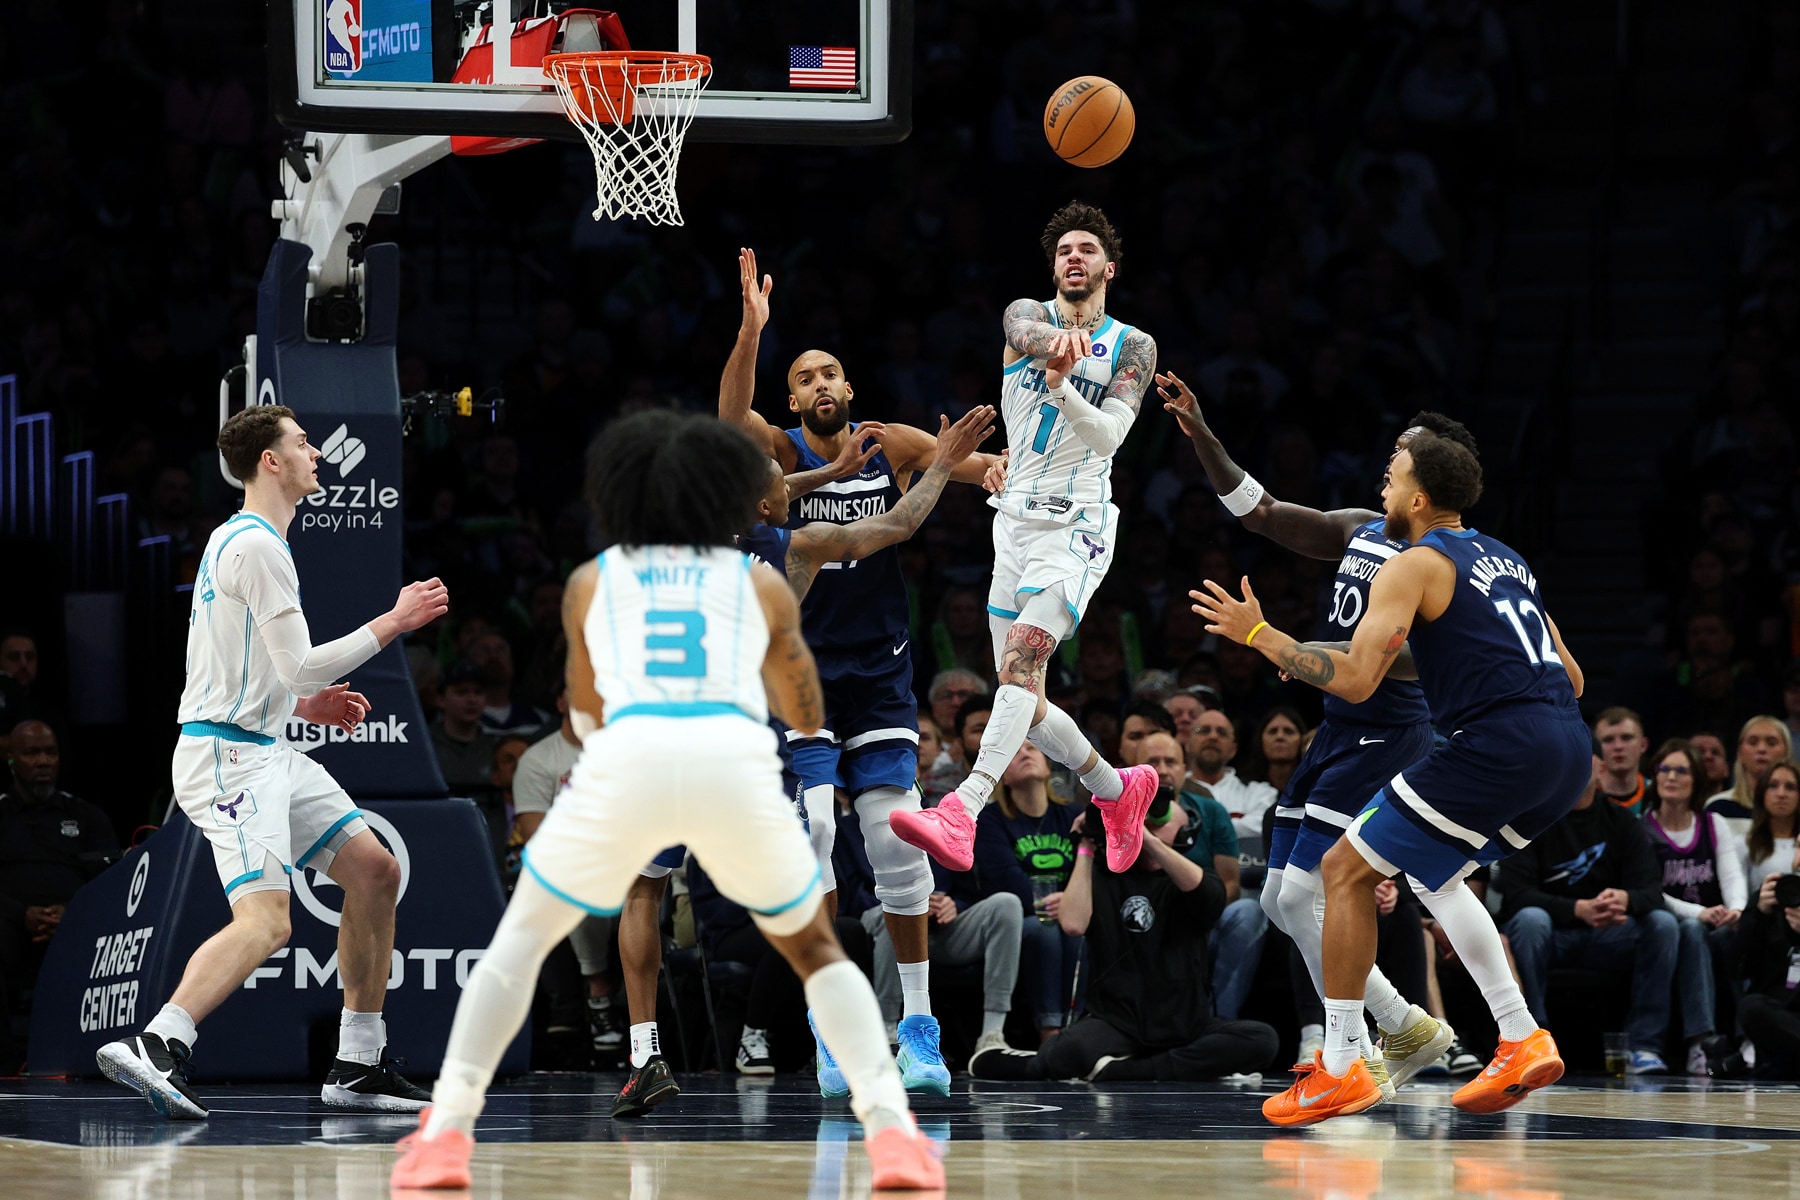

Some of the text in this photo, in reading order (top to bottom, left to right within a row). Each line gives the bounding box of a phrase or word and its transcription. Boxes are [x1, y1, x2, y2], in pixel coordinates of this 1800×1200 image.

[329, 52, 348, 67] NBA
[361, 22, 420, 59] CFMOTO
[1048, 81, 1095, 129] Wilson
[1031, 401, 1060, 455] 1
[296, 478, 400, 509] ezzle
[800, 495, 887, 521] MINNESOTA
[302, 510, 384, 533] pay in 4
[632, 564, 711, 589] WHITE
[1469, 556, 1537, 598] ANDERSON
[1328, 581, 1363, 628] 30
[644, 609, 707, 678] 3
[1492, 597, 1564, 667] 12
[285, 714, 409, 743] us bank
[89, 926, 154, 980] TARGET
[80, 979, 140, 1033] CENTER
